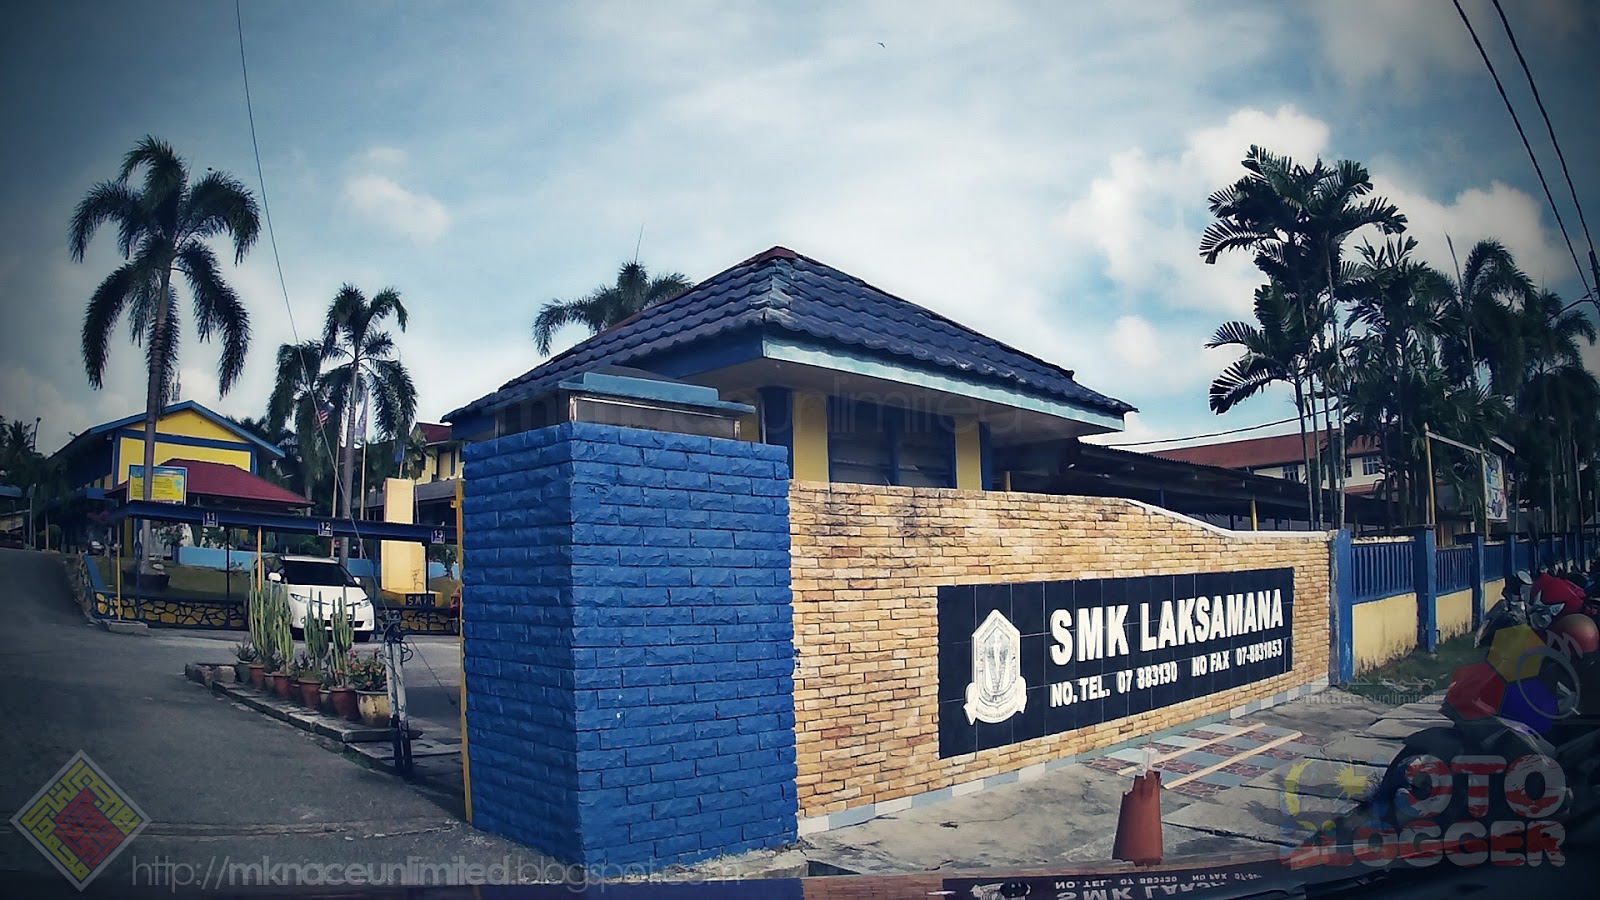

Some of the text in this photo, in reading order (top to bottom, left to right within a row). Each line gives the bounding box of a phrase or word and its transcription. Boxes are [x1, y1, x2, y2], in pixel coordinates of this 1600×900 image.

[320, 521, 331, 531] 12
[1049, 604, 1130, 666] SMK
[1139, 588, 1284, 652] LAKSAMANA
[1116, 669, 1134, 694] 07
[1136, 661, 1178, 690] 883130
[1191, 655, 1208, 677] NO
[1210, 650, 1230, 673] FAX
